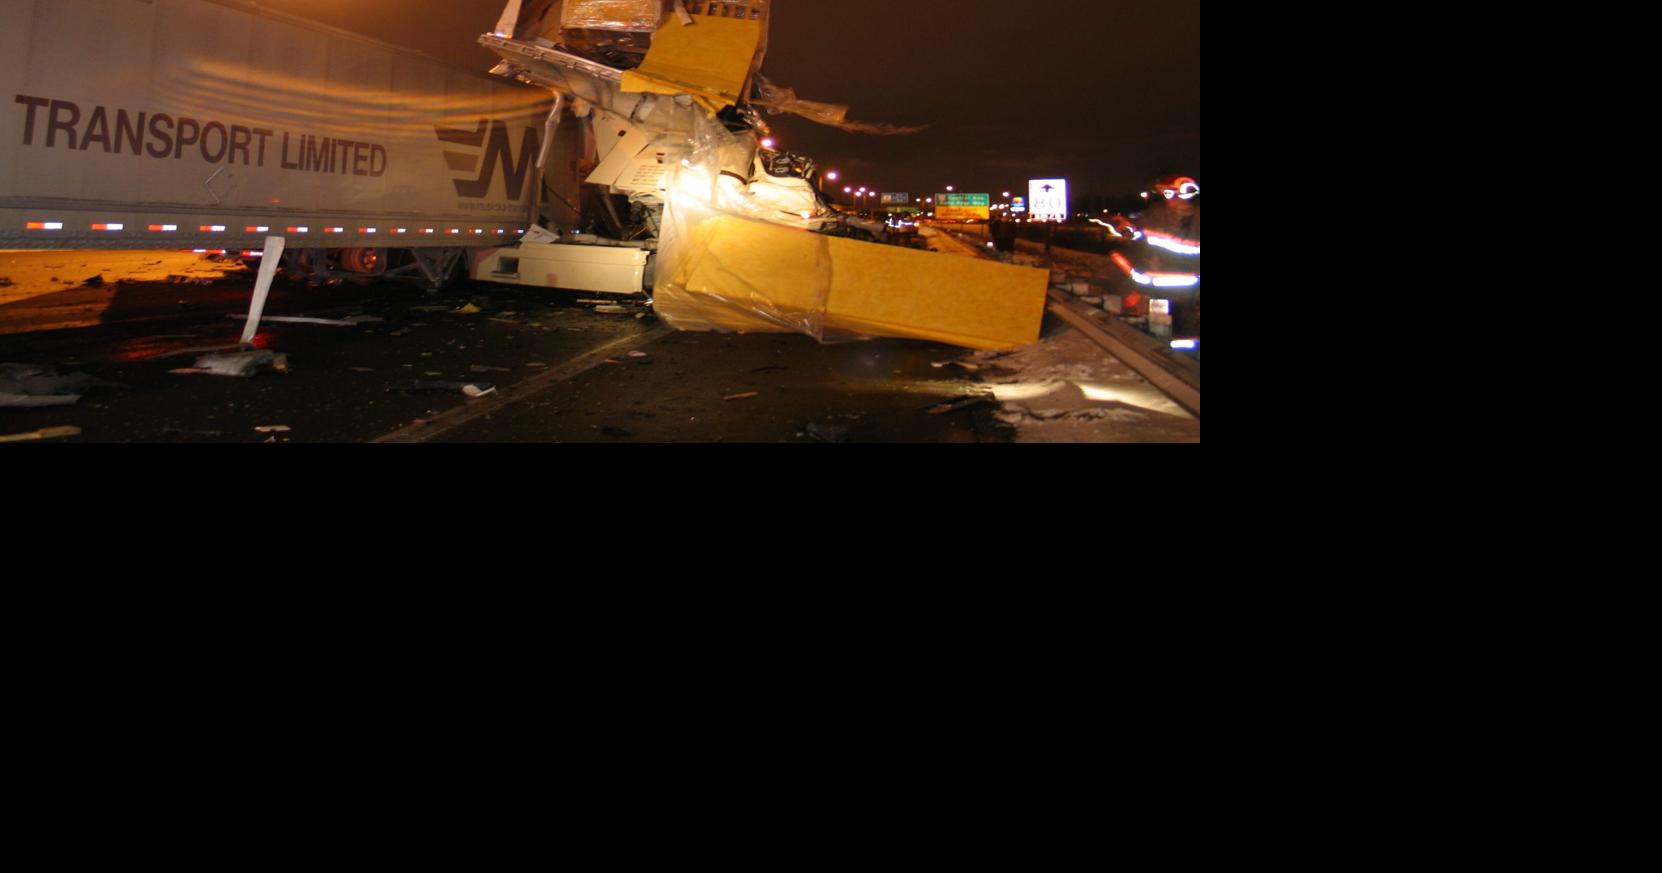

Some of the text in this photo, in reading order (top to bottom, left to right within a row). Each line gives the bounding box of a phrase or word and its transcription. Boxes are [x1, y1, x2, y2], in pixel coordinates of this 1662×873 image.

[15, 94, 387, 177] TRANSPORT LIMITED
[1033, 195, 1061, 209] 80
